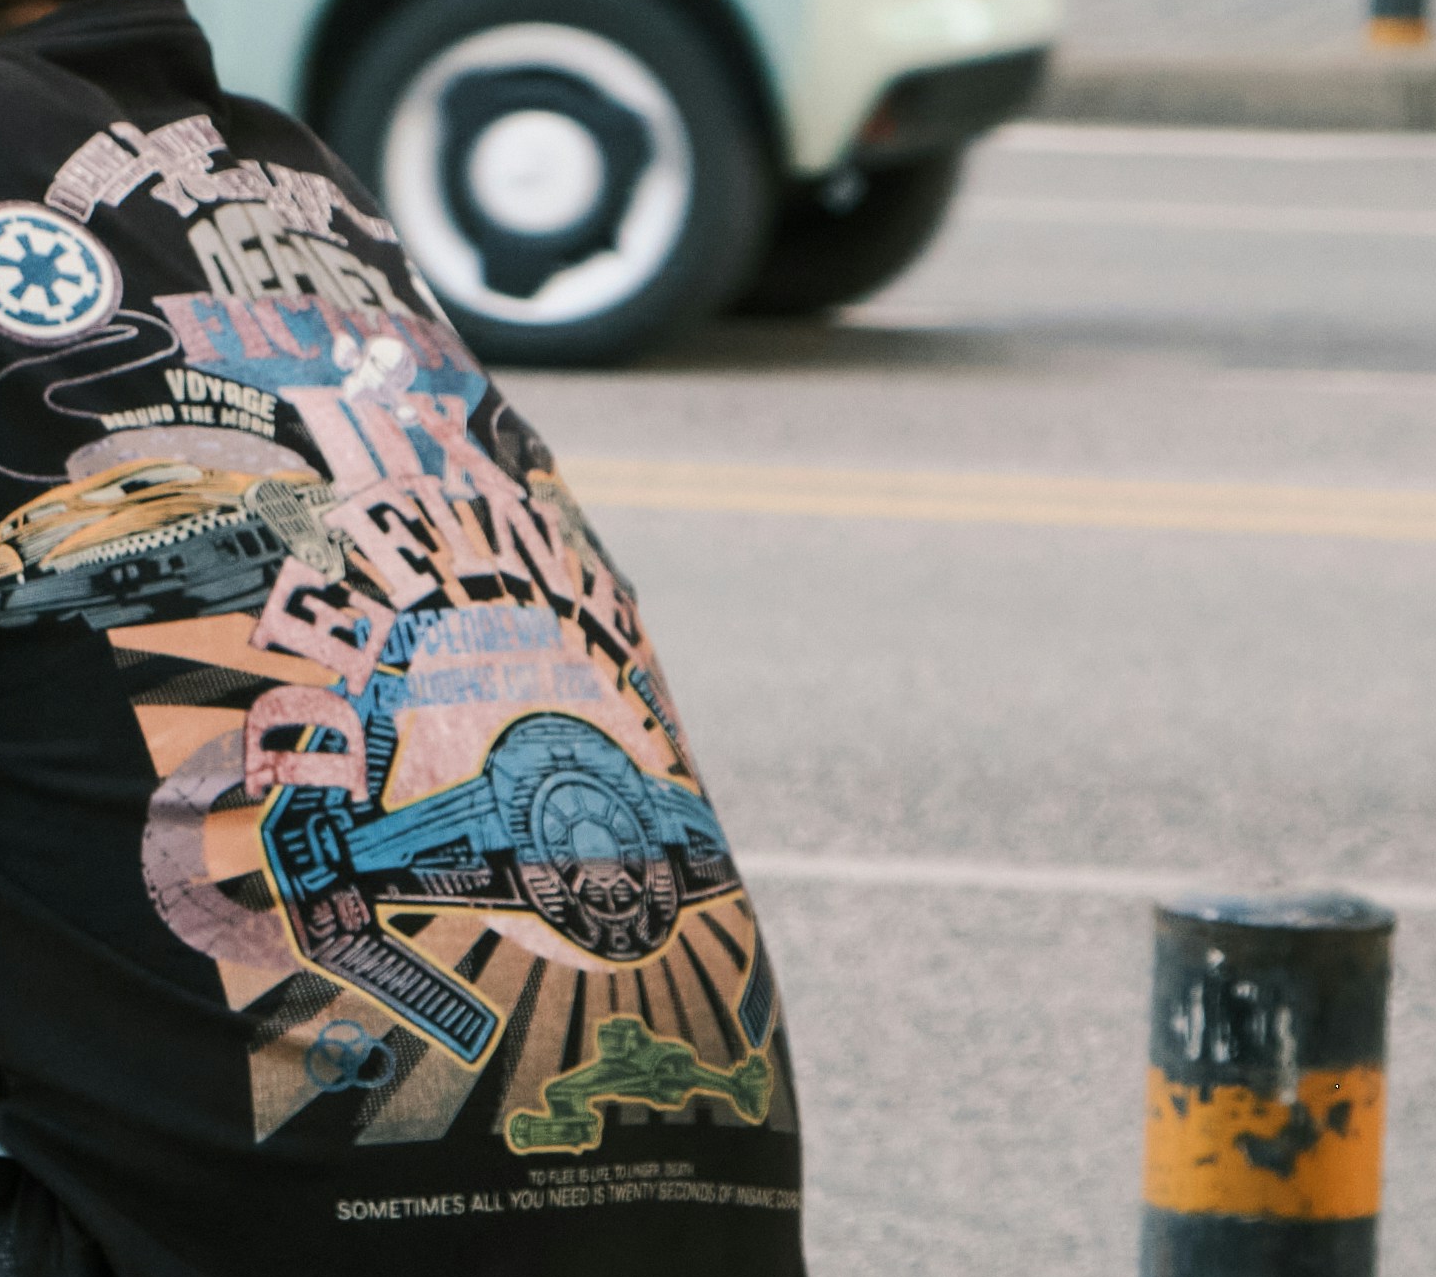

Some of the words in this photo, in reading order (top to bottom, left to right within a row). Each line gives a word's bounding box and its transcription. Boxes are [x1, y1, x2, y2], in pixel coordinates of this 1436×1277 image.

[164, 368, 278, 421] VOYAGE
[179, 404, 215, 424] THE
[219, 406, 277, 440] MOON
[529, 1169, 546, 1186] TO
[336, 1194, 466, 1221] SOMETIMES
[471, 1192, 504, 1213] ALL
[509, 1189, 545, 1210] YOU
[547, 1184, 590, 1207] NEED
[593, 1184, 606, 1205] IS
[609, 1180, 656, 1203] TWENTY
[658, 1179, 716, 1203] SECONDS
